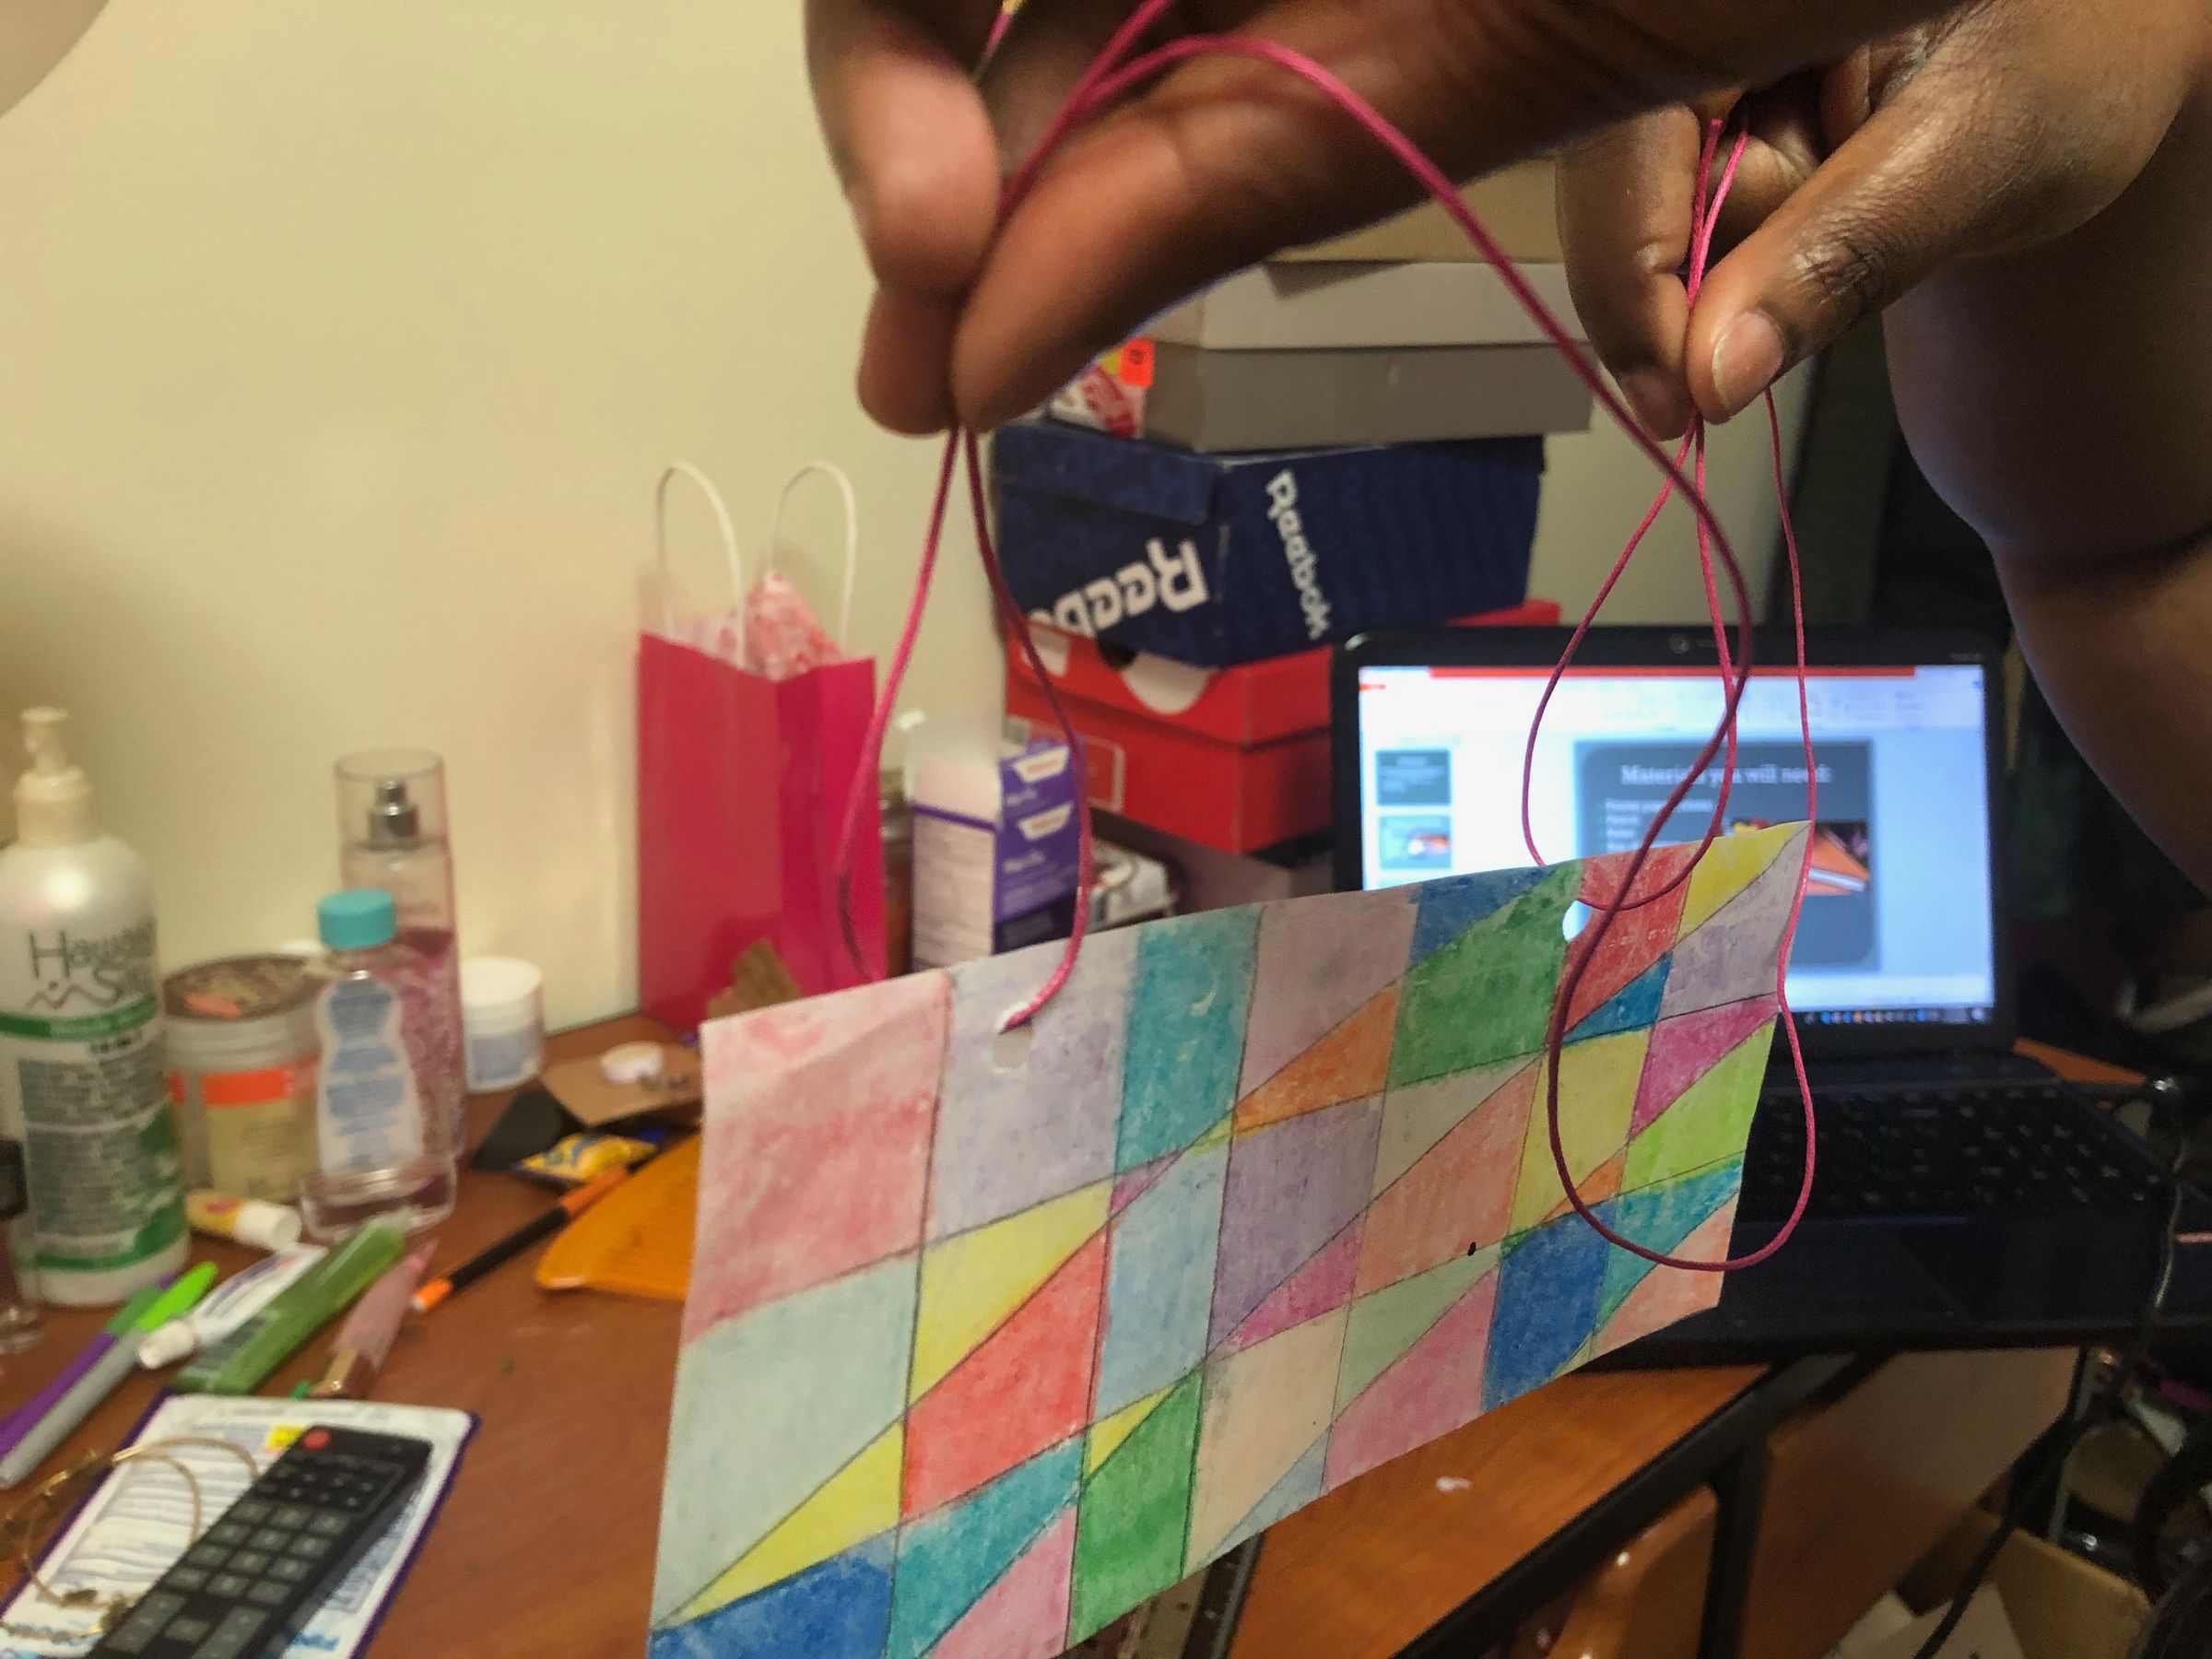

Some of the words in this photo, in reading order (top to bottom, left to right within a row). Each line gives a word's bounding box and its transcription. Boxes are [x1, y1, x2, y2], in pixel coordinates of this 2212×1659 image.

[1028, 536, 1208, 636] Reeb
[1266, 470, 1331, 640] Reebok
[1621, 764, 1704, 785] Materias
